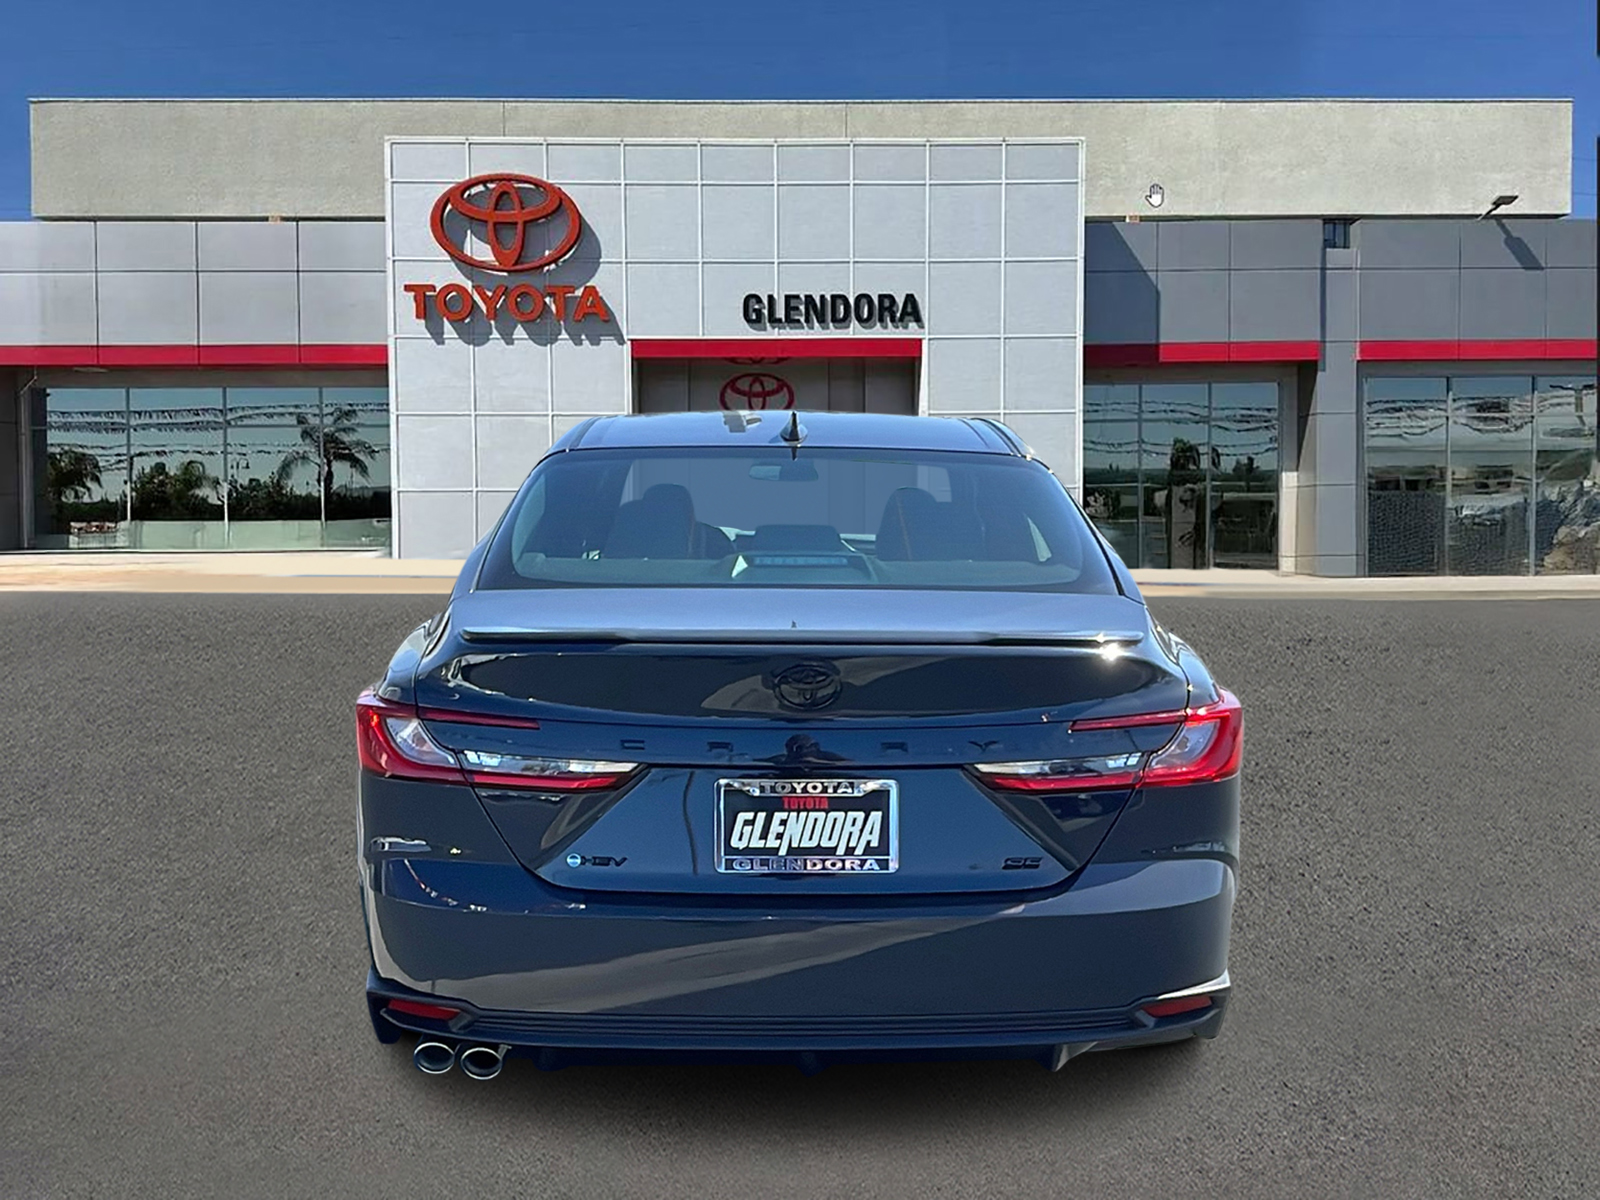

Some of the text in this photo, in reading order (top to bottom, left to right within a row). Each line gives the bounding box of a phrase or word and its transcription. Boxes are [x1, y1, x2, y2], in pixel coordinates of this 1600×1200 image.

[404, 284, 610, 322] TOYOTA
[742, 293, 922, 325] GLENDORA
[620, 739, 999, 753] CARY
[759, 782, 853, 794] TOYOTA
[782, 797, 828, 809] TOYOTA
[730, 811, 882, 856] GLENDORA
[732, 858, 880, 870] GLENDORA
